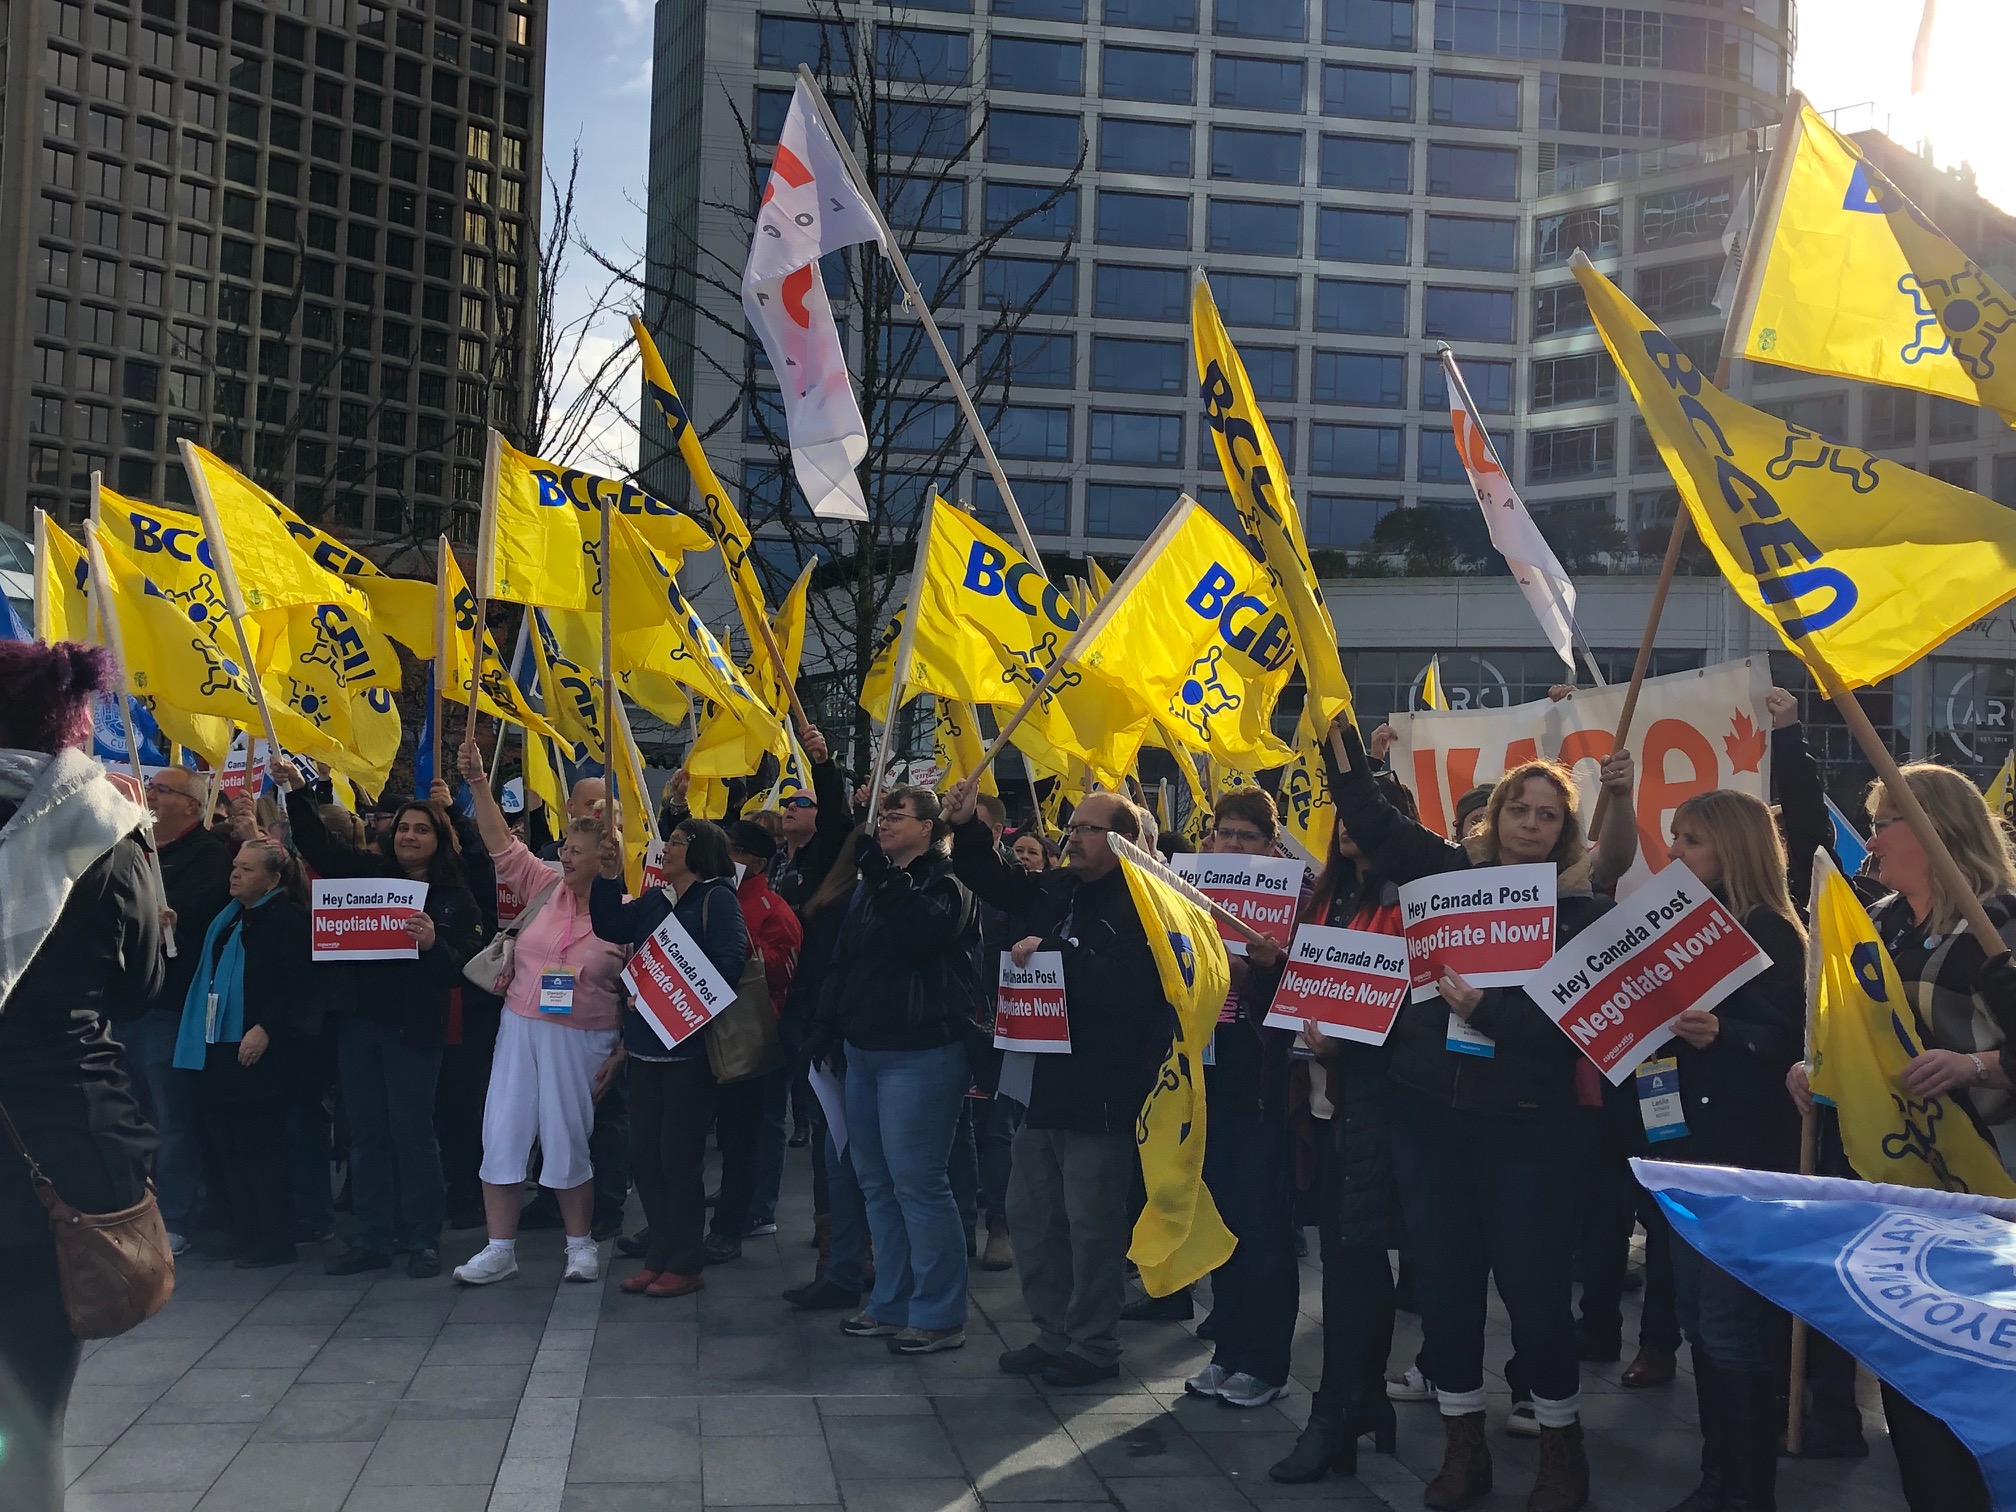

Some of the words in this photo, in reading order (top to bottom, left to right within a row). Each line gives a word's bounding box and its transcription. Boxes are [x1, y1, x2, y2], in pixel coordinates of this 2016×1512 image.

[1204, 870, 1250, 886] Canada
[1255, 873, 1288, 890] Post
[322, 893, 343, 907] Hey
[346, 893, 383, 904] Canada
[387, 892, 413, 904] Post
[1241, 900, 1291, 924] Now!
[1408, 901, 1427, 920] Hey
[1430, 889, 1493, 911] Canada
[1499, 885, 1539, 904] Post
[316, 915, 378, 935] Negotiate
[1408, 924, 1486, 960] Negotiate
[1490, 917, 1550, 944] Now!
[1300, 942, 1324, 963] Hey
[1325, 946, 1371, 968] Canada
[1373, 953, 1404, 973] Post
[1551, 969, 1591, 1005] Hey
[1586, 928, 1650, 973] Canada
[1645, 889, 1692, 930] Post
[658, 927, 671, 947] Hey
[667, 942, 698, 981] Canada
[694, 978, 718, 1005] Post
[1035, 970, 1056, 984] Post
[1570, 965, 1674, 1046] Negotiate
[1663, 909, 1733, 970] Now!
[639, 941, 674, 993] Negotiate
[668, 988, 704, 1028] Now!
[1282, 970, 1355, 1001] Negotiate
[1355, 982, 1402, 1009] Now!
[1033, 997, 1065, 1017] Now!
